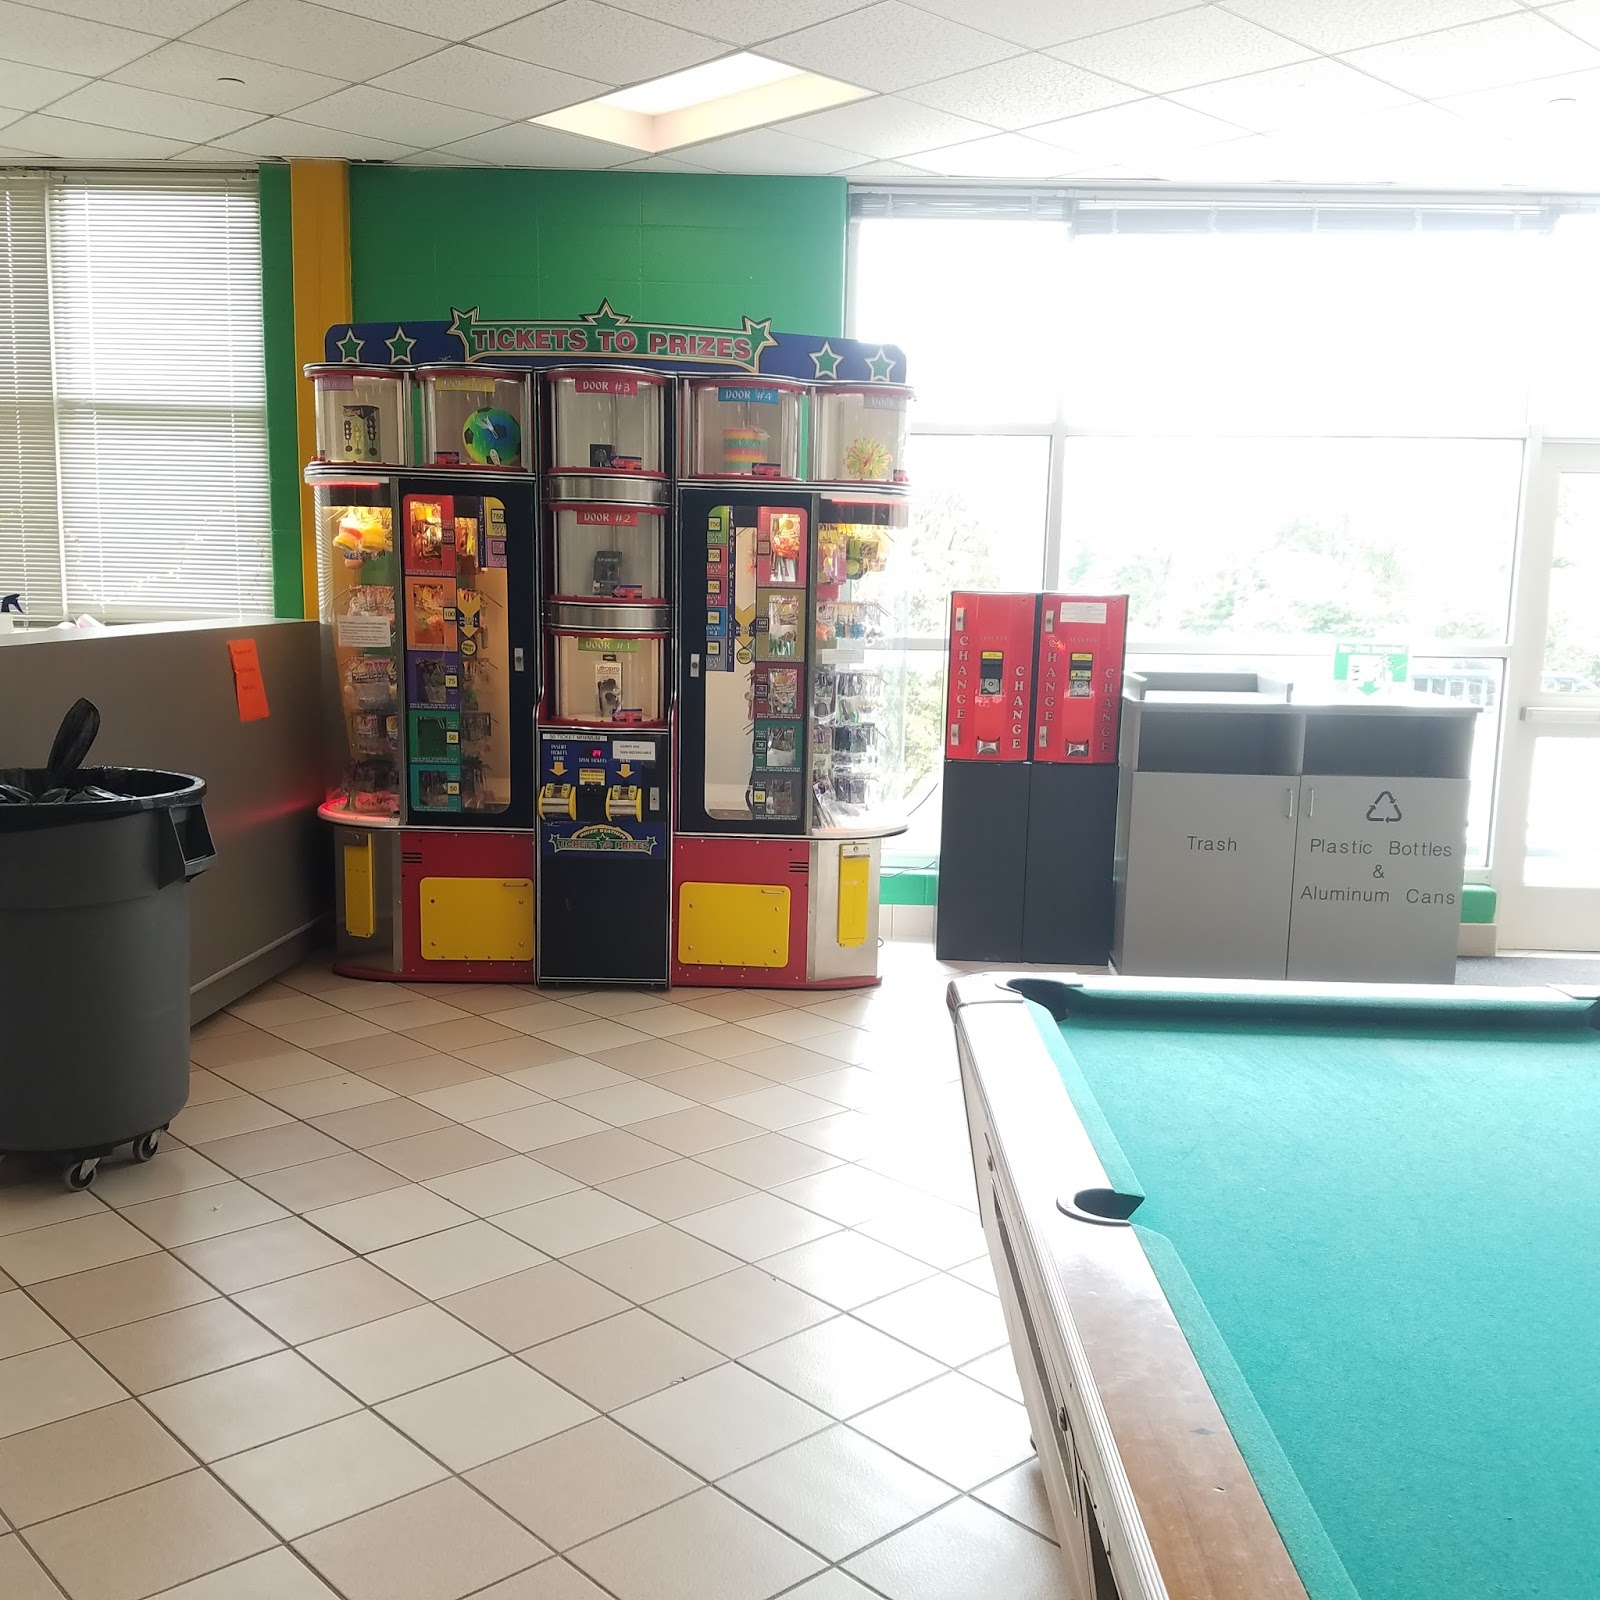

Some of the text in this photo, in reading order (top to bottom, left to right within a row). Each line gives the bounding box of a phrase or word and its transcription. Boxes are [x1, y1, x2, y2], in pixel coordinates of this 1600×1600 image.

[472, 329, 752, 360] TICKETS TO PRIZES
[582, 381, 631, 392] DOOR #3
[725, 389, 773, 401] DOOR #4
[584, 512, 631, 523] DOOR #2
[585, 640, 611, 650] DOOR
[956, 635, 969, 719] CHANGE
[1044, 638, 1058, 722] CHANGE
[1011, 665, 1026, 750] CHANGE
[1101, 667, 1115, 751] CHANGE
[557, 840, 651, 850] TICKETS TO PRIZES
[1186, 835, 1238, 852] Trash
[1309, 838, 1453, 857] Plastic Bottles
[1372, 864, 1385, 879] &
[1300, 885, 1456, 905] Aluminum Cans
